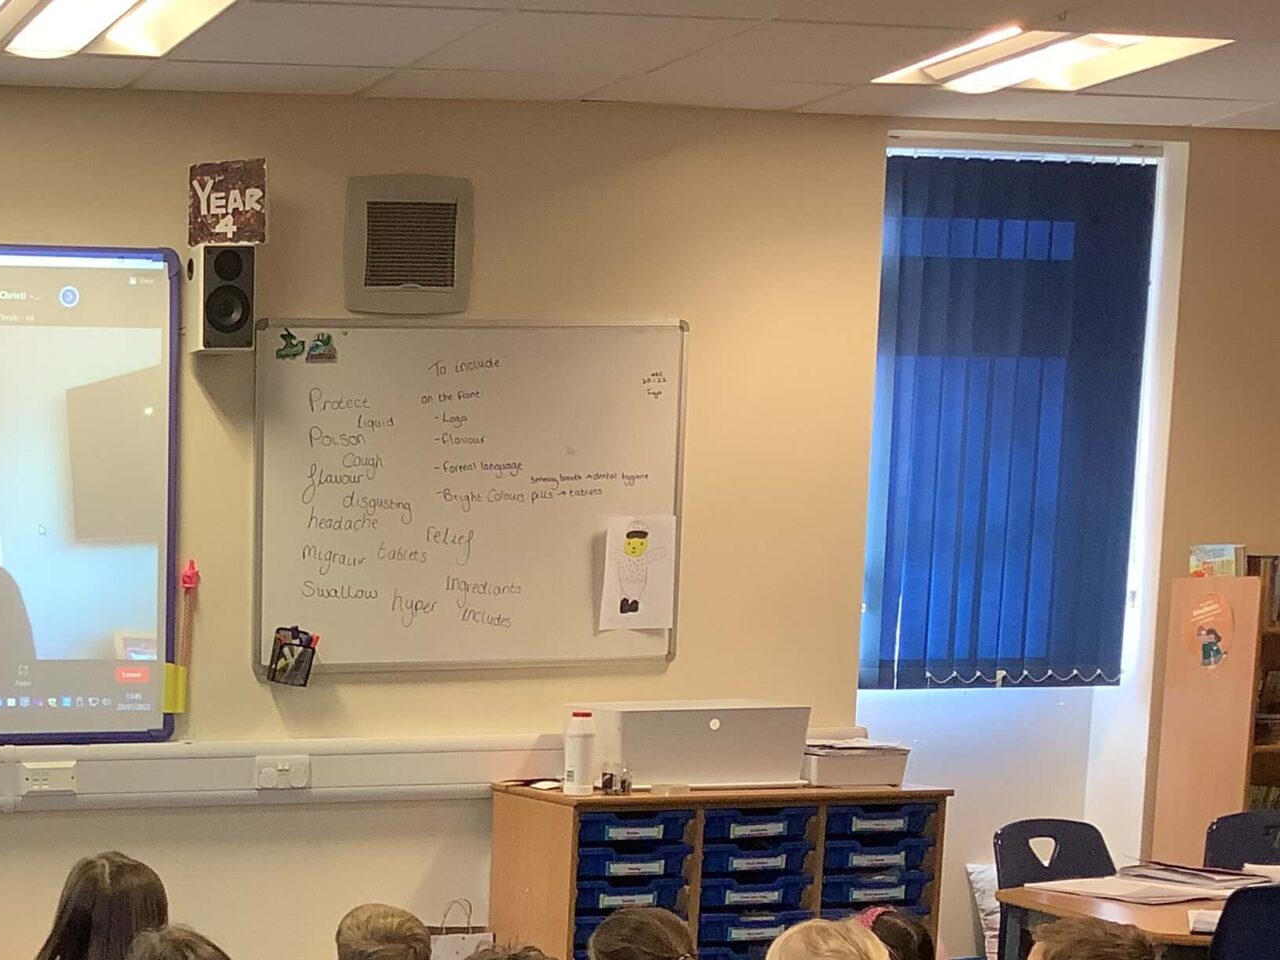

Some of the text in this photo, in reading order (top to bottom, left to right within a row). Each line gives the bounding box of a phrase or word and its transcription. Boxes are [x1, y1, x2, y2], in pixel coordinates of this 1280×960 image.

[192, 178, 263, 216] YEAR
[215, 214, 237, 239] 4
[428, 359, 447, 376] To
[308, 387, 371, 412] Protect
[309, 425, 366, 448] Poison
[480, 461, 523, 479] language
[307, 506, 379, 531] headache
[342, 490, 413, 525] disgusting
[426, 525, 475, 566] relief
